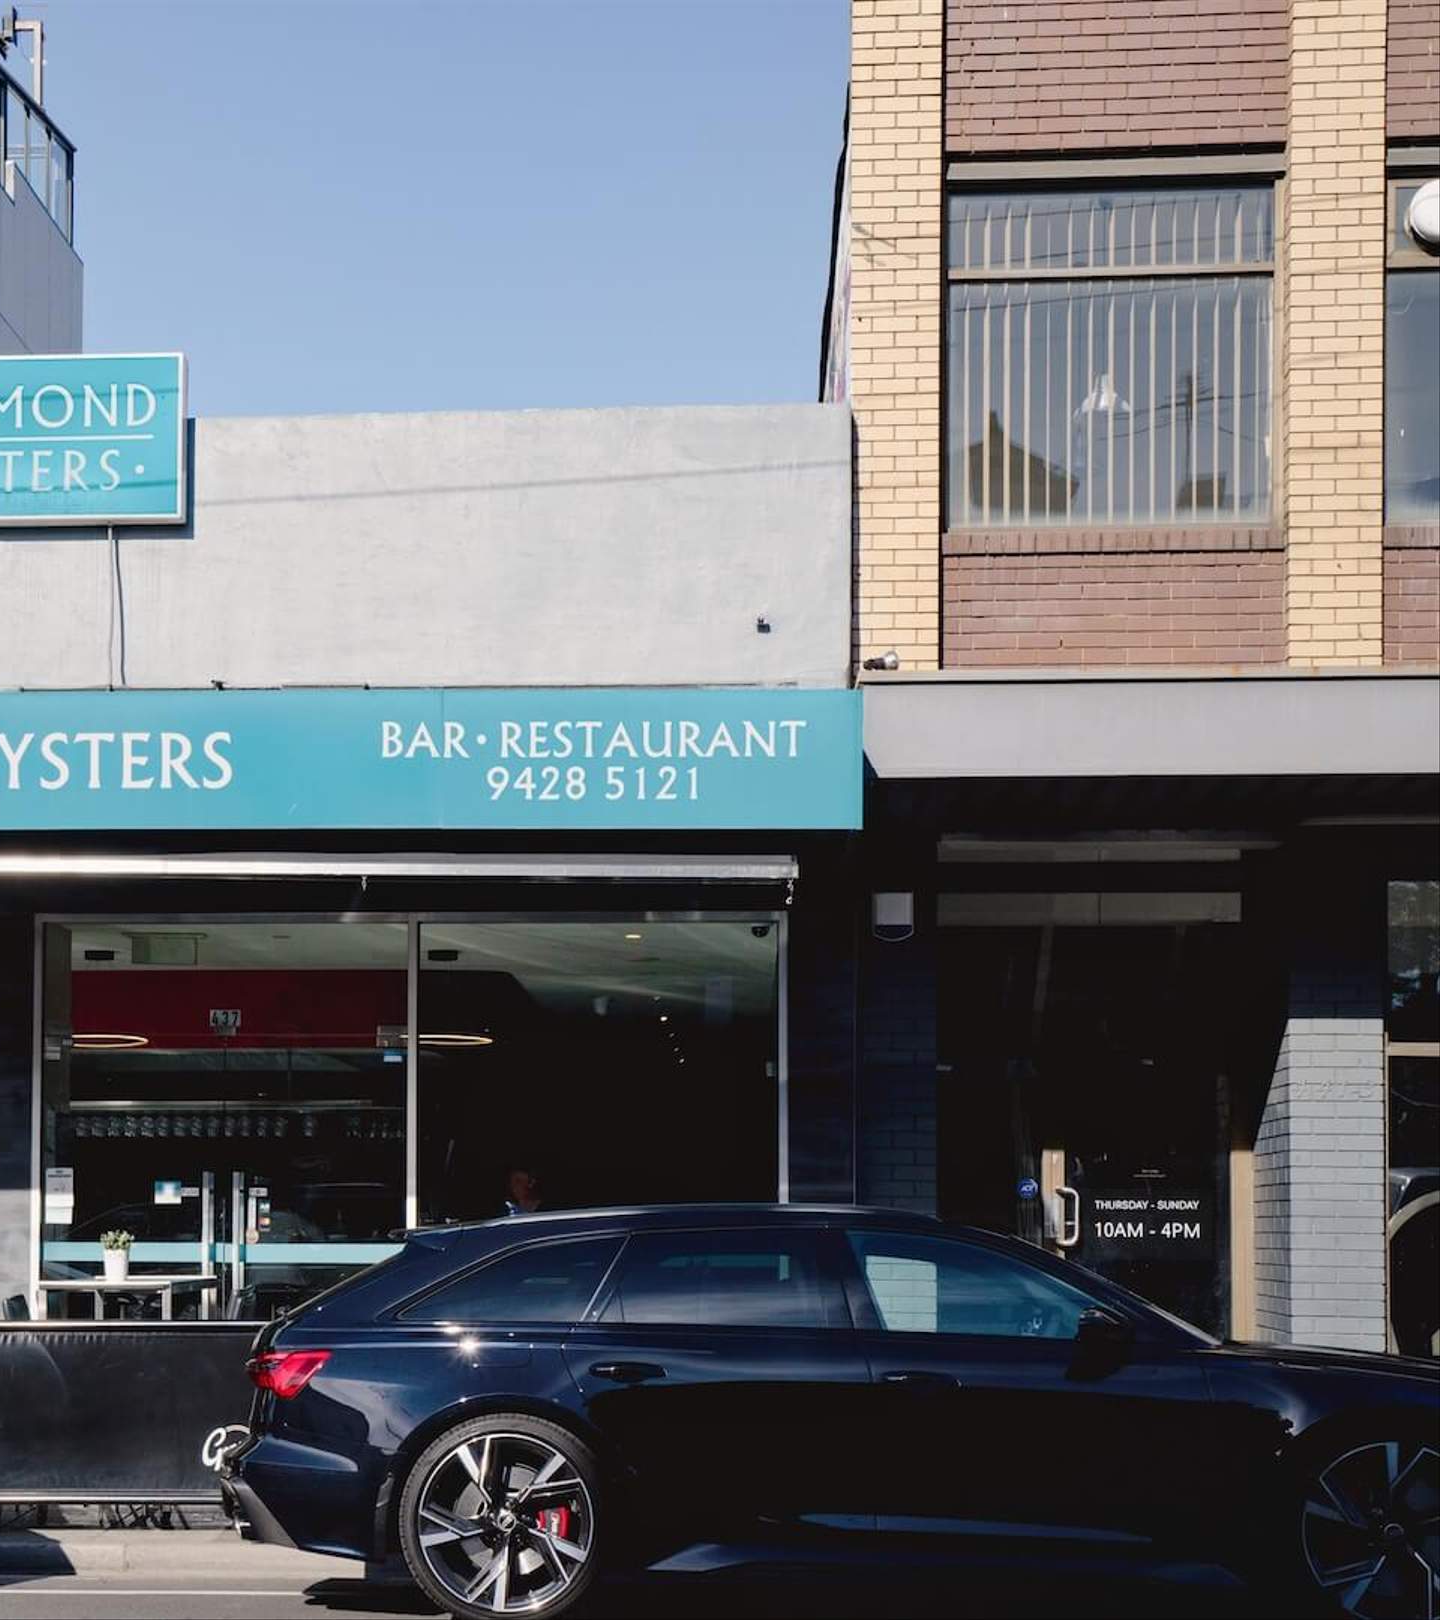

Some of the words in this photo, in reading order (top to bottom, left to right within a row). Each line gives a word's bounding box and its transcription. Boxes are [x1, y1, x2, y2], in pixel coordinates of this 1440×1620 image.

[381, 721, 470, 758] BAR
[500, 720, 807, 758] RESTAURANT
[486, 766, 587, 800] 9428
[605, 766, 700, 800] 5121
[1094, 1200, 1148, 1210] THURSDAY
[1157, 1200, 1199, 1210] SUNDAY
[1094, 1222, 1143, 1238] 10AM
[1161, 1222, 1201, 1238] 4PM
